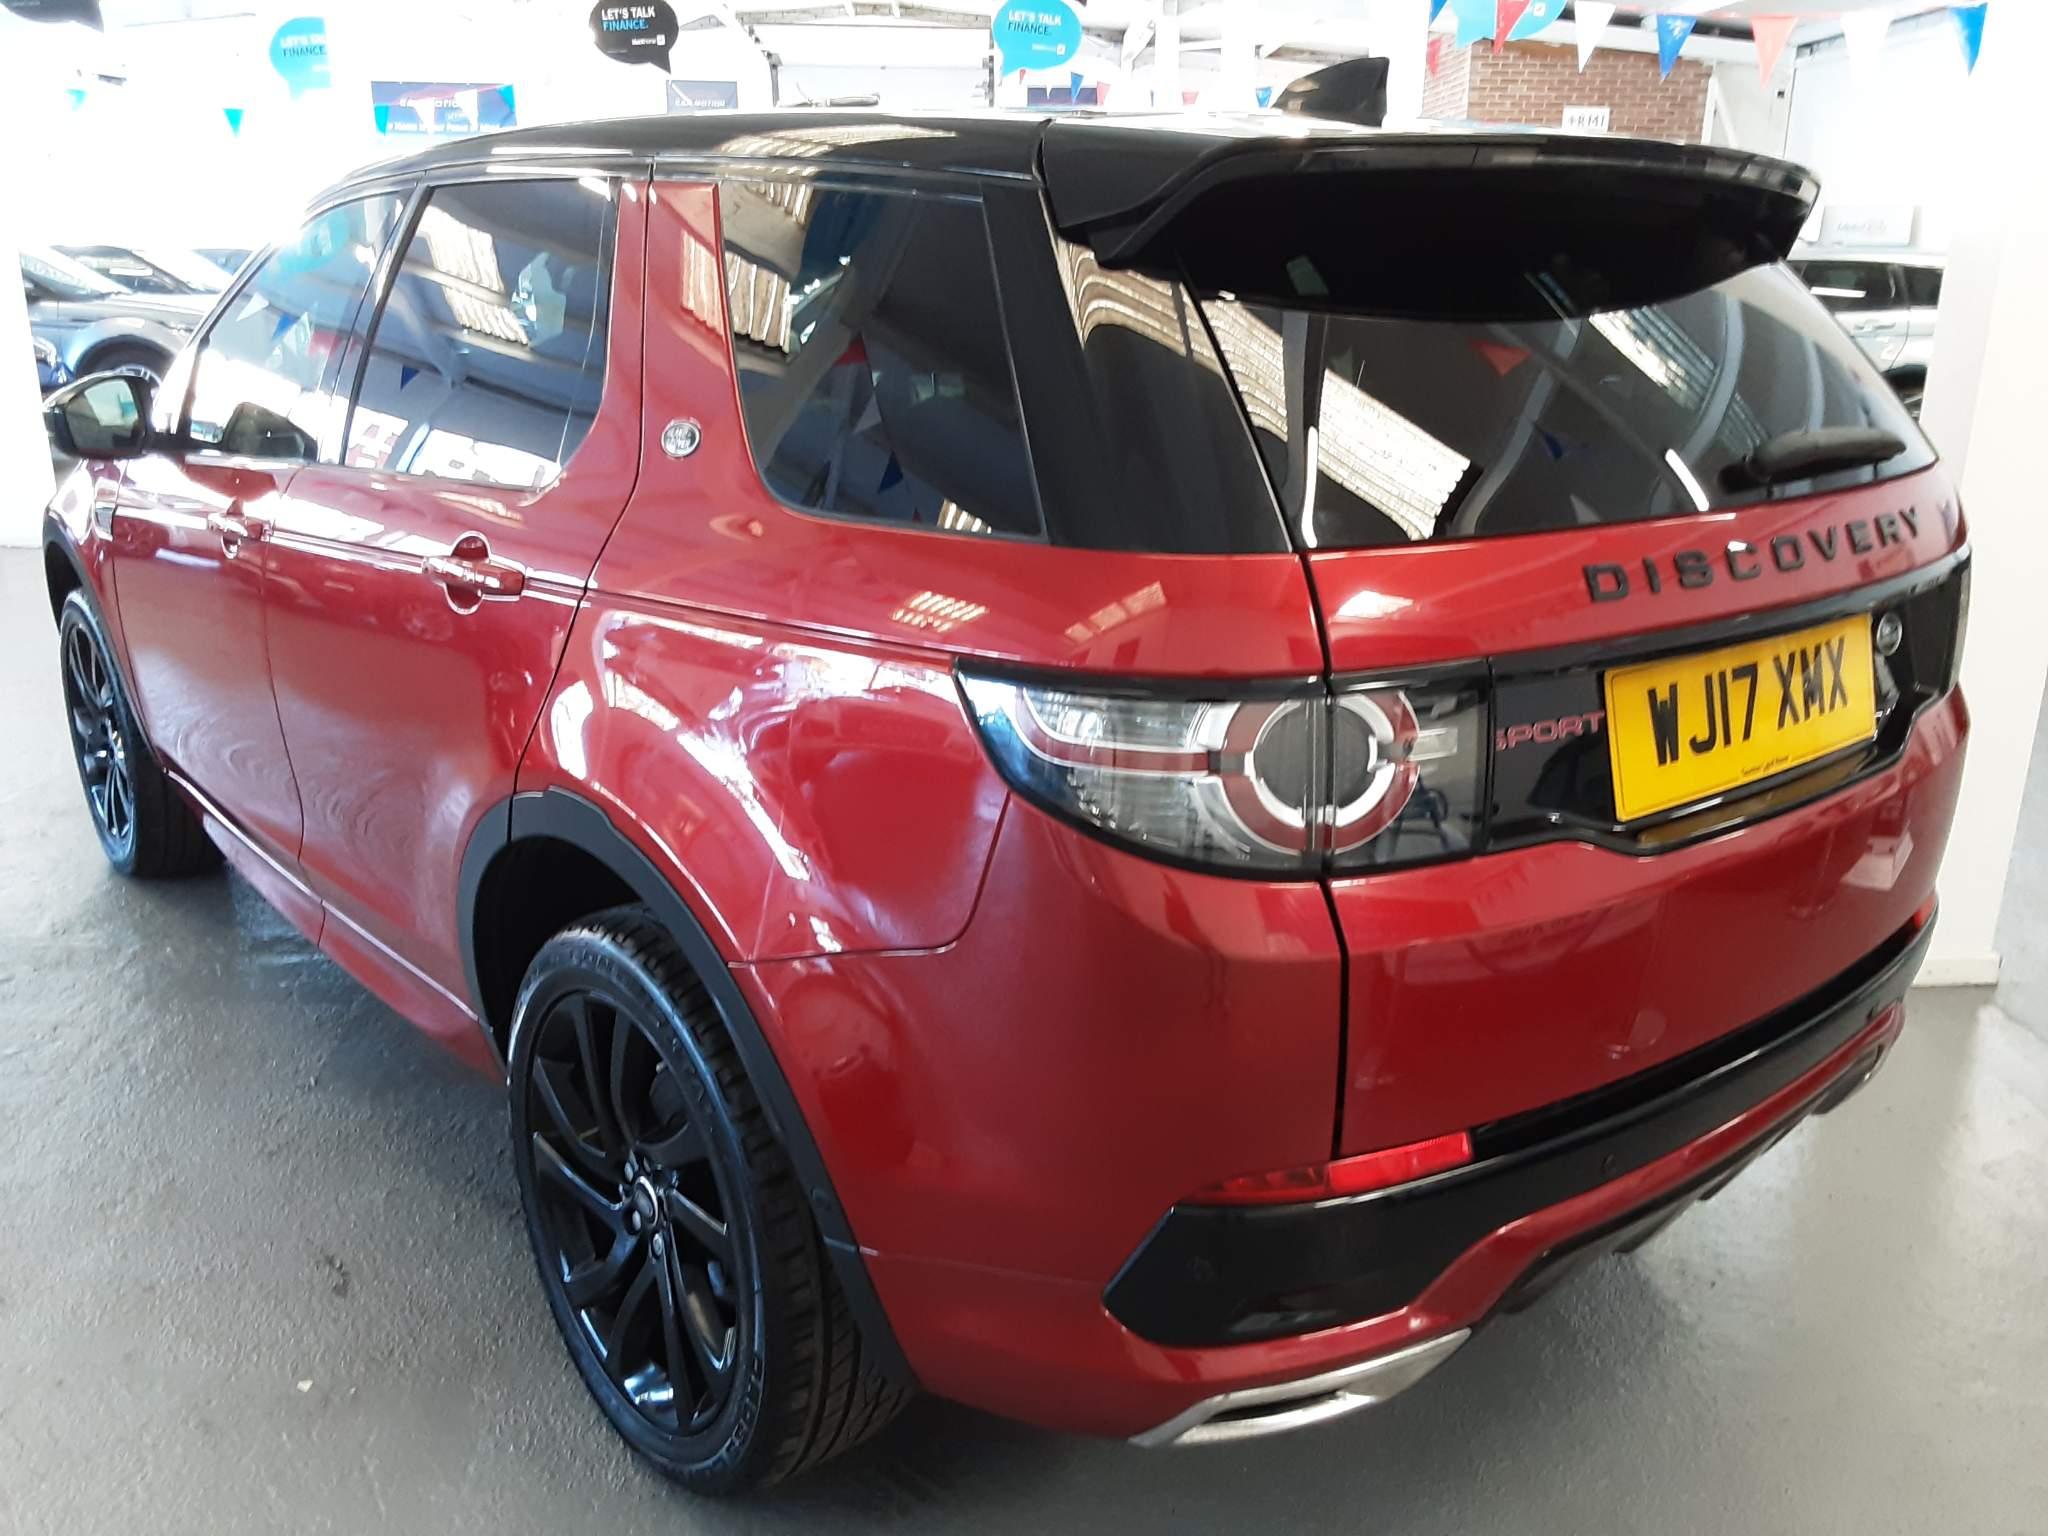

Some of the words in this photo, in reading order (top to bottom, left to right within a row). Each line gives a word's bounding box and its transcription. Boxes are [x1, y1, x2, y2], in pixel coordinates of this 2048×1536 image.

[601, 7, 629, 20] LET'S
[630, 5, 656, 18] TALK
[1038, 13, 1062, 26] TALK
[1583, 507, 1921, 602] DISCOVERY
[1647, 661, 1759, 768] WJ17
[1772, 635, 1848, 731] XMX
